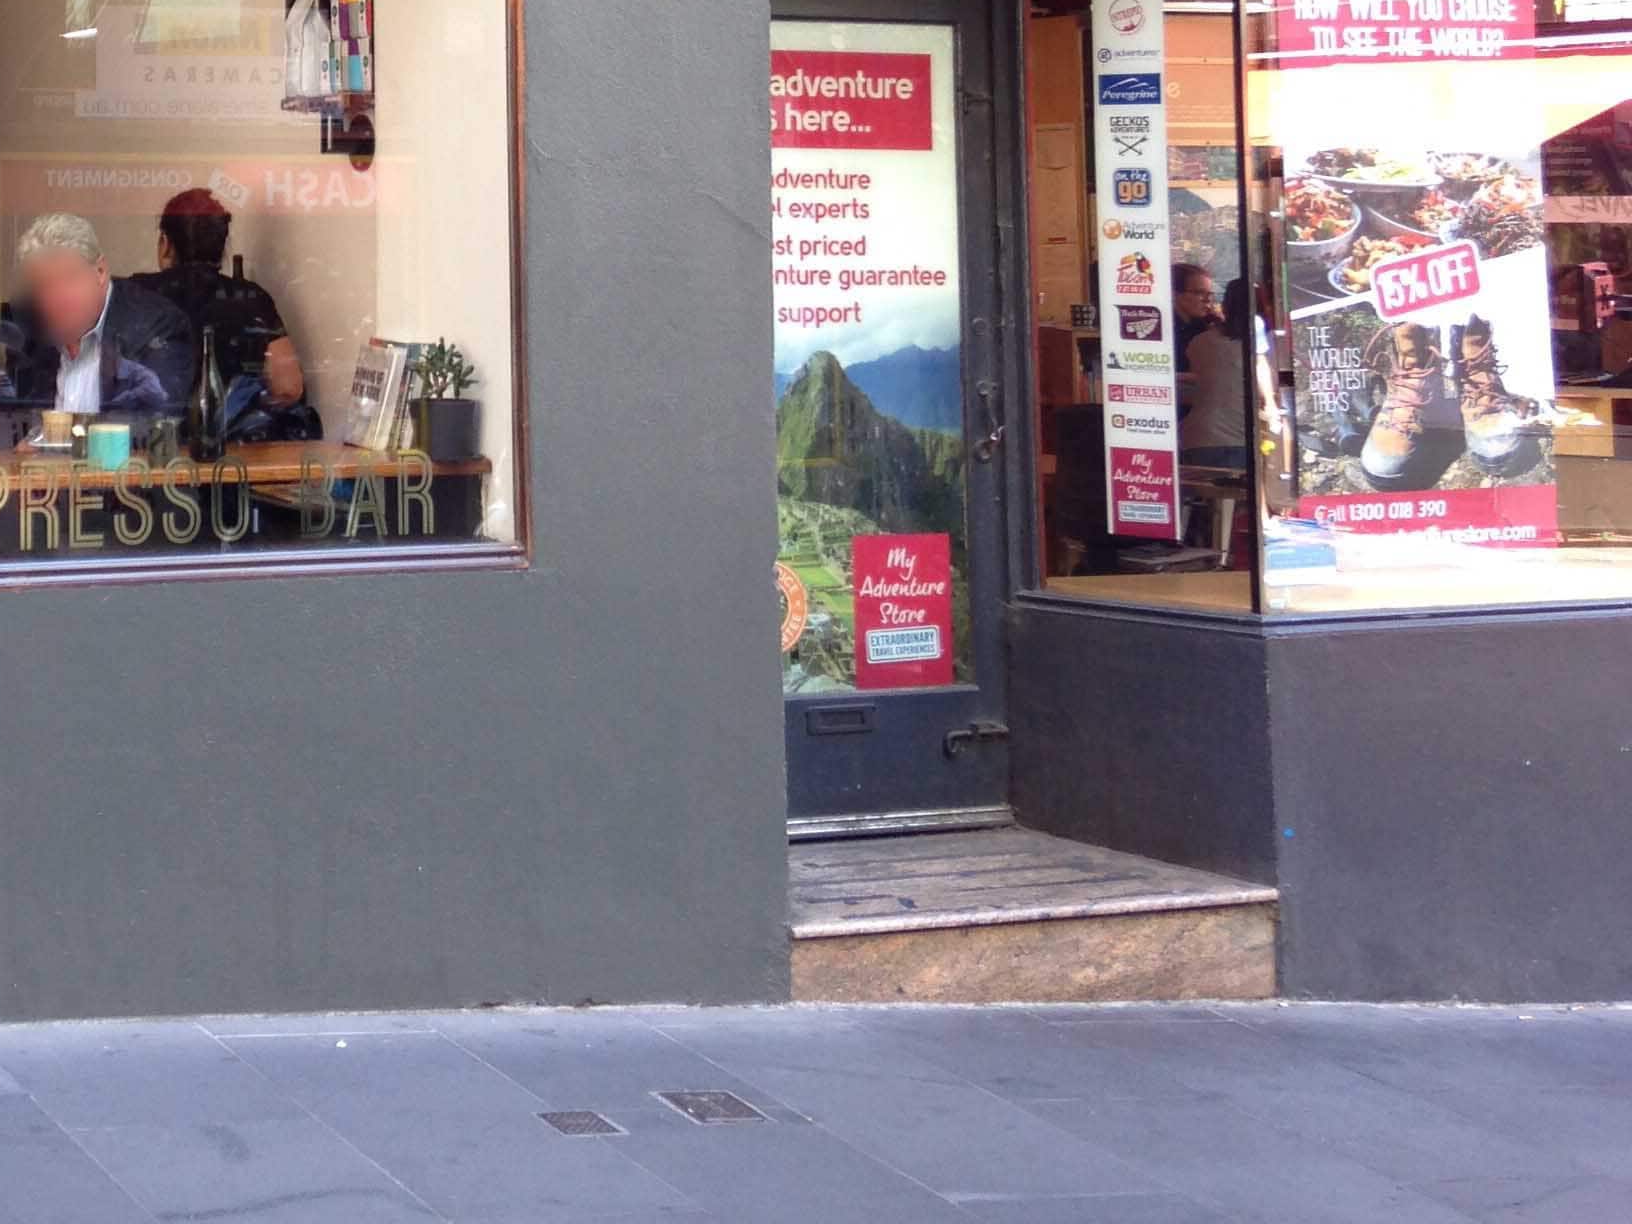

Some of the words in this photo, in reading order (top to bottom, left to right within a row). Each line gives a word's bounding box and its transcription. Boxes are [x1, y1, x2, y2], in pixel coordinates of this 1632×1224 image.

[1309, 27, 1338, 55] TO
[1344, 27, 1377, 55] SEE
[1386, 27, 1424, 56] THE
[770, 68, 914, 100] adventure
[1102, 88, 1158, 101] Peregrine
[1110, 116, 1149, 127] GECKOS
[1119, 181, 1147, 203] go
[789, 200, 869, 223] experts
[1124, 230, 1154, 240] World
[800, 235, 866, 260] priced
[839, 265, 946, 290] guarantee
[1377, 263, 1428, 310] 15%
[1427, 251, 1472, 296] OFF
[778, 302, 862, 328] support
[1307, 326, 1331, 347] THE
[1123, 352, 1170, 364] WORLD
[1310, 370, 1368, 391] GREATEST
[1312, 392, 1349, 412] TREKS
[1126, 417, 1170, 429] exodus
[1131, 454, 1152, 474] My
[1114, 468, 1172, 486] Adventure
[299, 450, 434, 538] BAR
[1127, 485, 1159, 501] Store
[1349, 503, 1385, 520] 1300
[1388, 502, 1413, 518] 018
[1418, 500, 1446, 517] 390
[887, 547, 917, 580] My
[859, 576, 946, 598] Adventure
[879, 603, 926, 624] Store
[871, 631, 935, 647] EXTRAORDINARY
